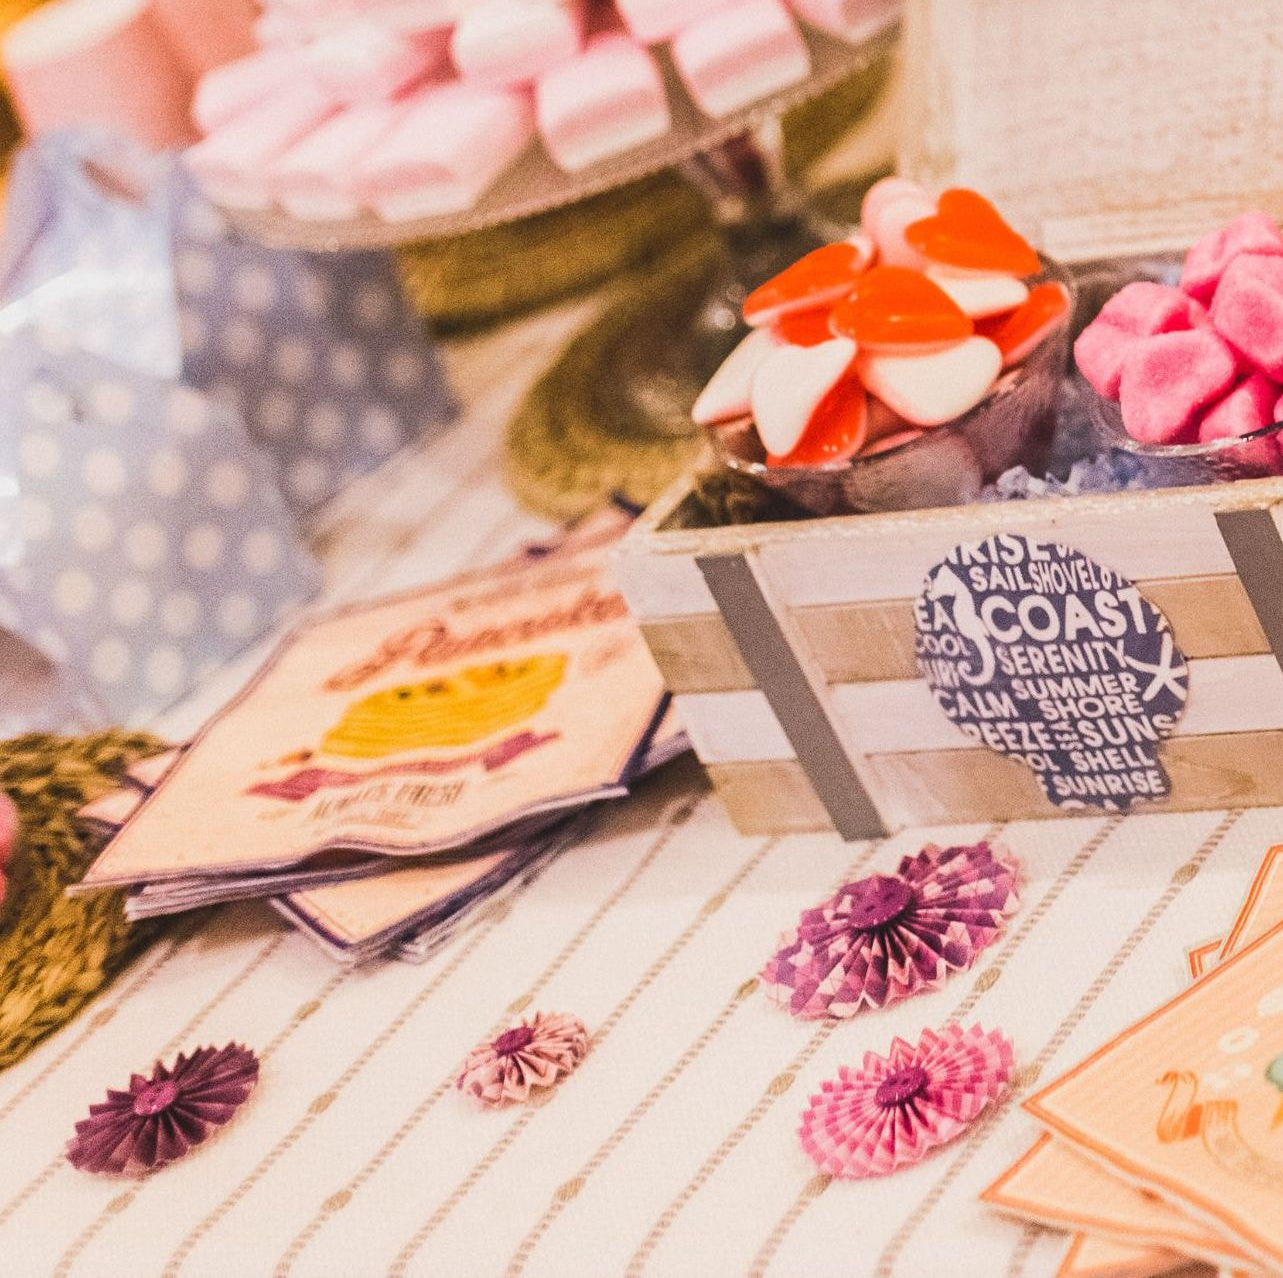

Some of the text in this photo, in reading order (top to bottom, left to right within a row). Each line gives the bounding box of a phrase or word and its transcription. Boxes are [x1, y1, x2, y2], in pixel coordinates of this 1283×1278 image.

[969, 564, 1031, 593] SAIL
[1027, 556, 1101, 595] SHOVEL
[980, 585, 1149, 644] COAST
[995, 637, 1132, 676] SERENITY
[1010, 671, 1142, 701] SUMMER
[931, 689, 1020, 720] CALM
[1037, 691, 1145, 722] SHORE
[1068, 744, 1156, 773] SHELL
[1051, 768, 1167, 797] SUNRISE
